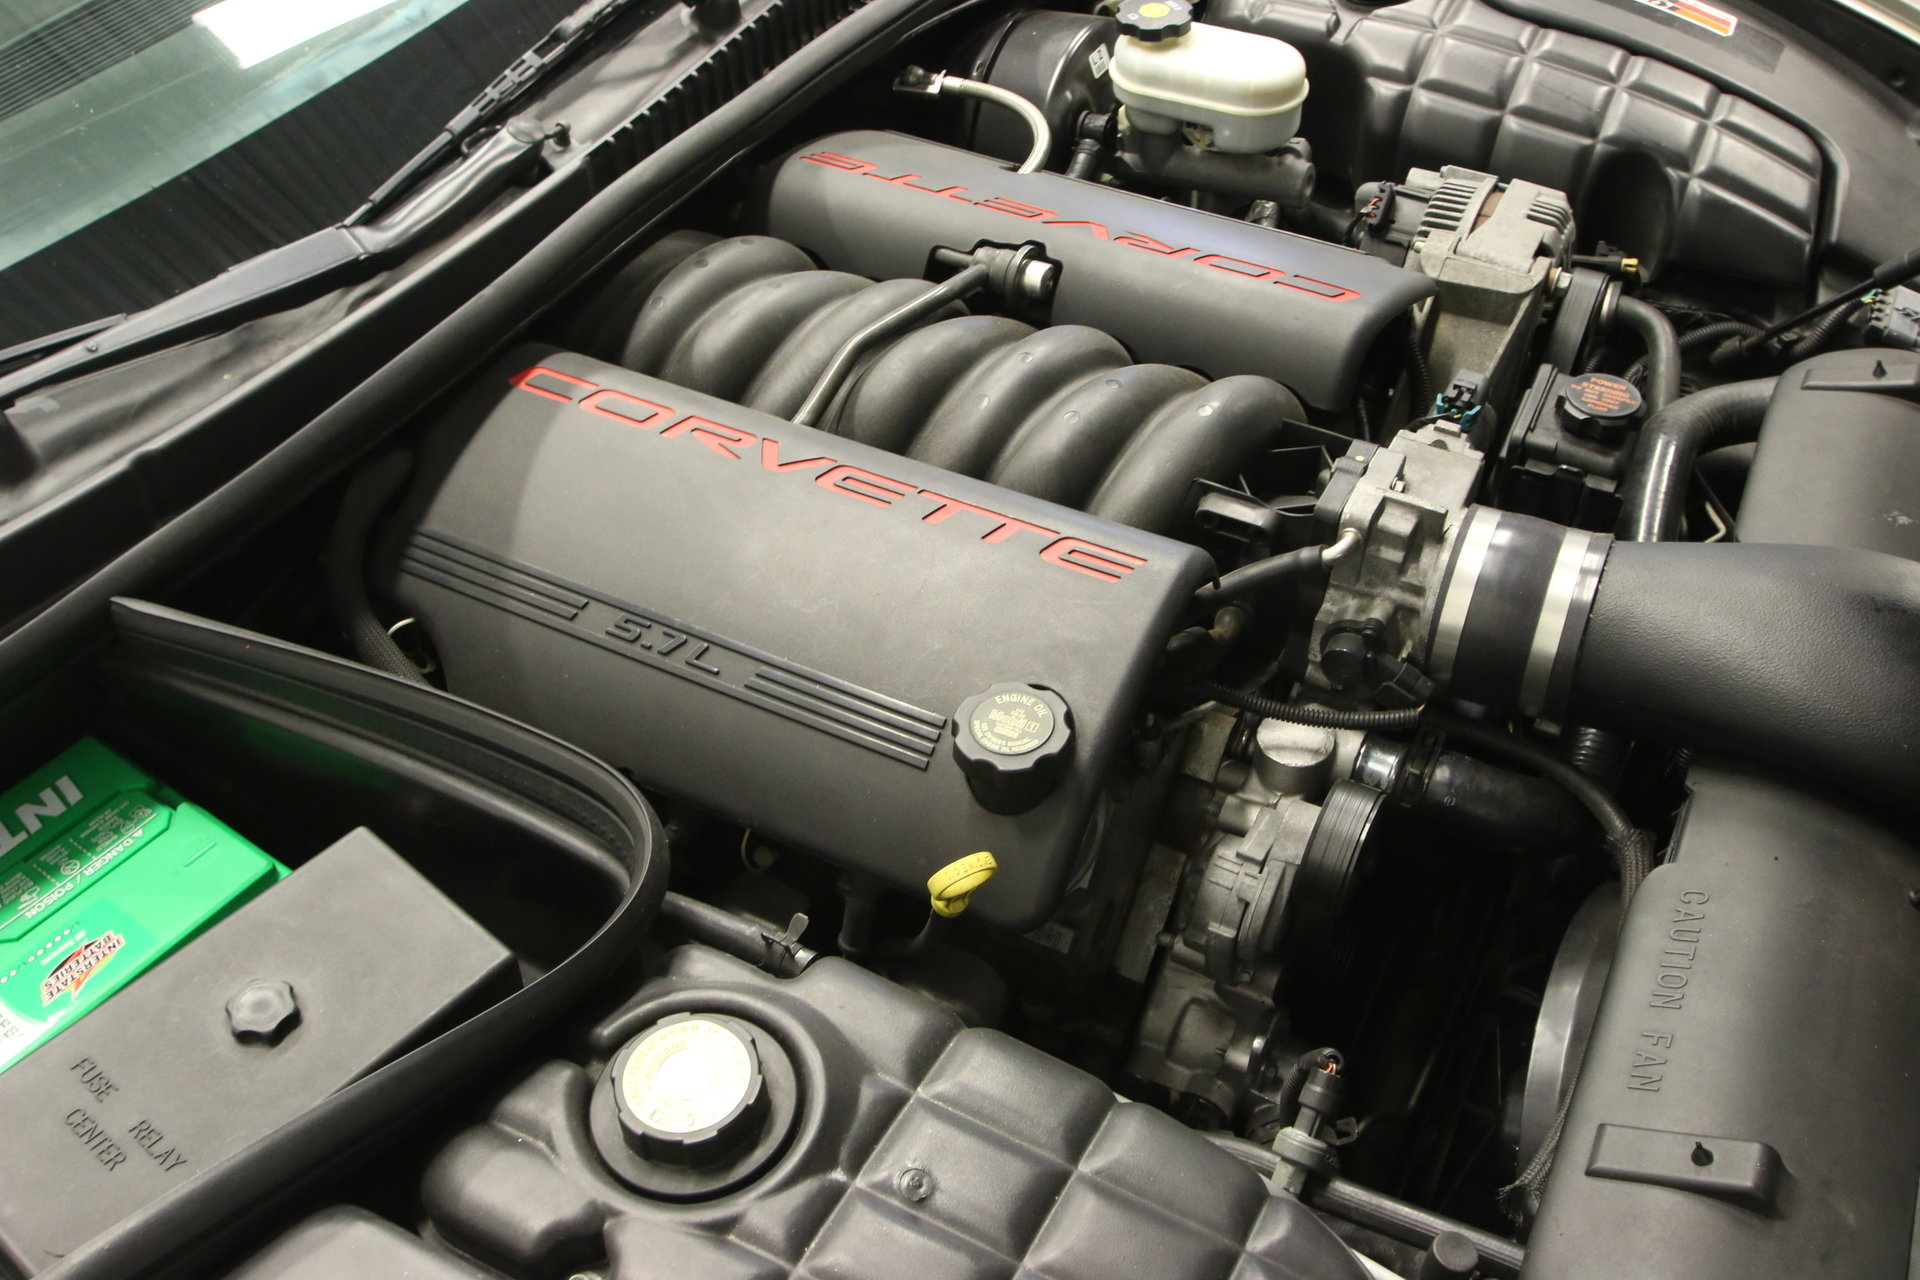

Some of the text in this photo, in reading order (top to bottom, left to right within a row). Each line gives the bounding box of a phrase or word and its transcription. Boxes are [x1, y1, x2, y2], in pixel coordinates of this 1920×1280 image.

[800, 151, 1361, 302] CORVETTE
[508, 366, 1148, 582] CORVETTE
[605, 612, 720, 676] 5.7L
[994, 693, 1049, 718] ENGINE OIL
[84, 838, 135, 877] DANGER
[24, 880, 74, 919] POISON
[43, 935, 111, 989] BATTERIES
[45, 938, 121, 1001] INTERSTATE
[1627, 890, 1710, 1092] CAUTION FAN
[64, 1108, 127, 1172] CENTER
[70, 1057, 188, 1172] FUSE RELAY
